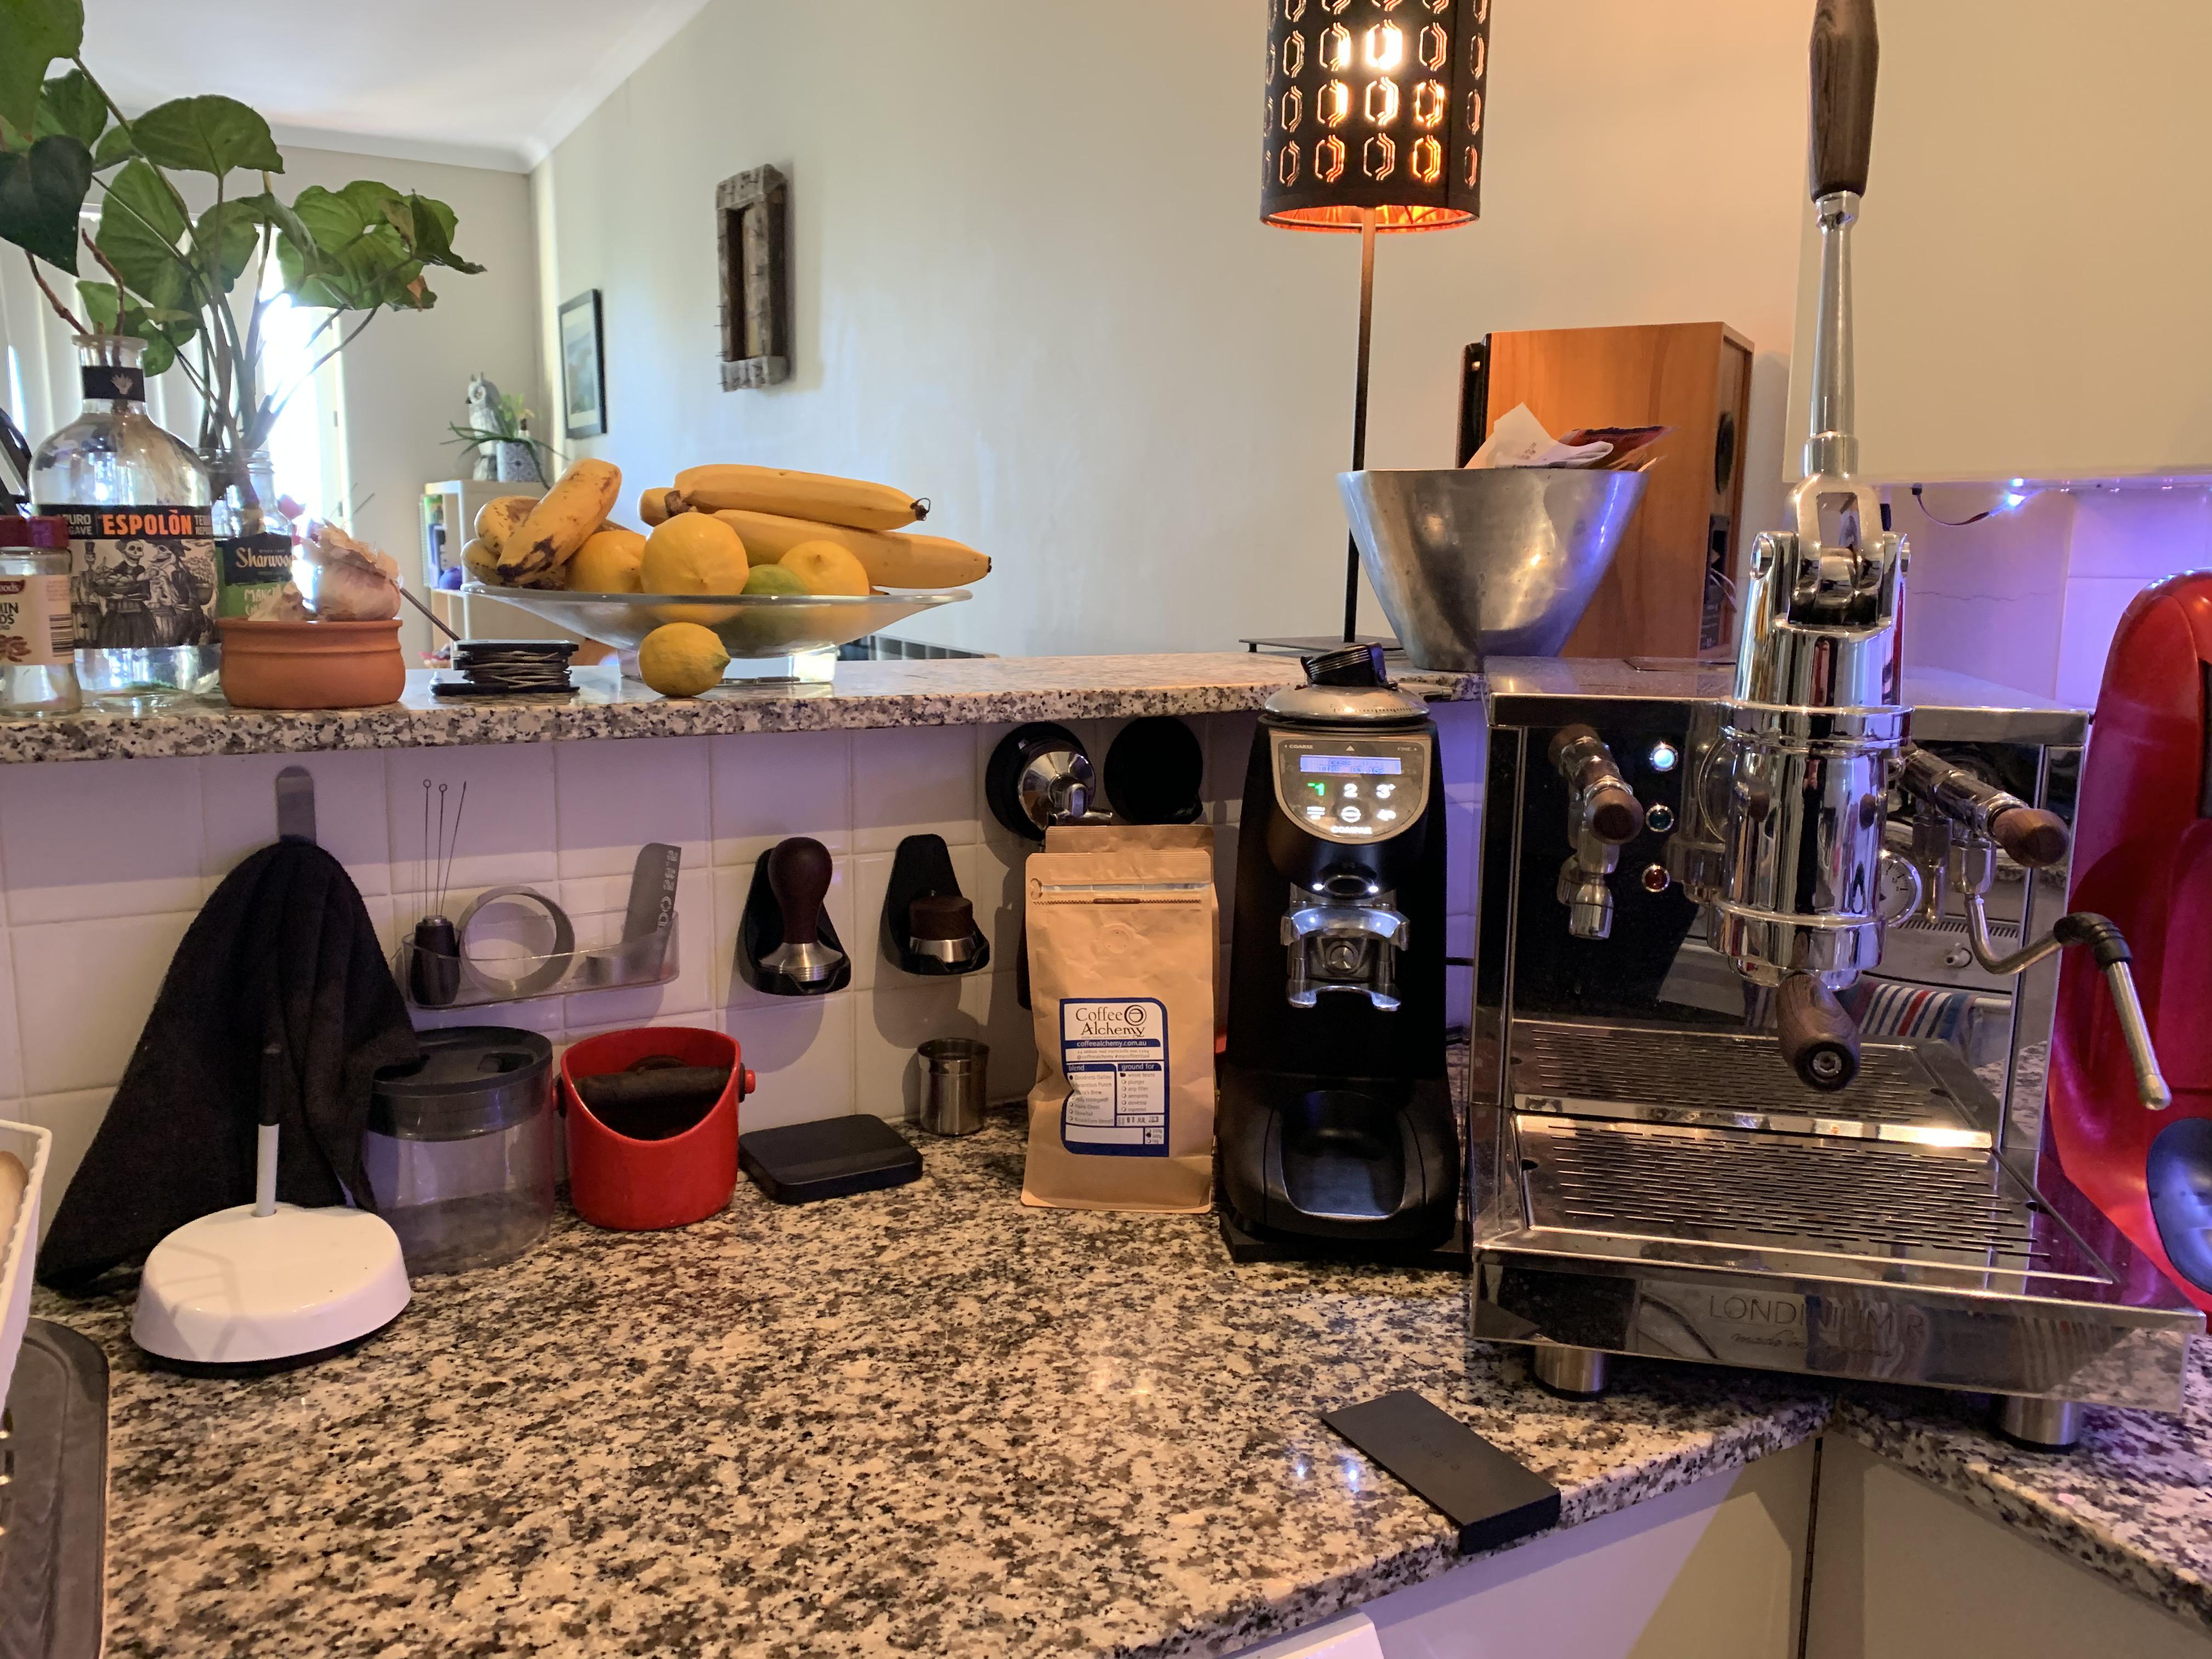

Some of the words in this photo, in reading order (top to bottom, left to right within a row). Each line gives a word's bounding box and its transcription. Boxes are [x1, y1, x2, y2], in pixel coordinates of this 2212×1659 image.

[69, 526, 93, 535] GAVE
[235, 547, 292, 568] Sharwoo
[1344, 783, 1358, 798] 2
[1075, 1006, 1123, 1022] Coffee
[1080, 1021, 1146, 1039] Alchemy
[1076, 1040, 1147, 1048] coffeealchemy.com.au
[1710, 1295, 1894, 1336] LONDINIUM
